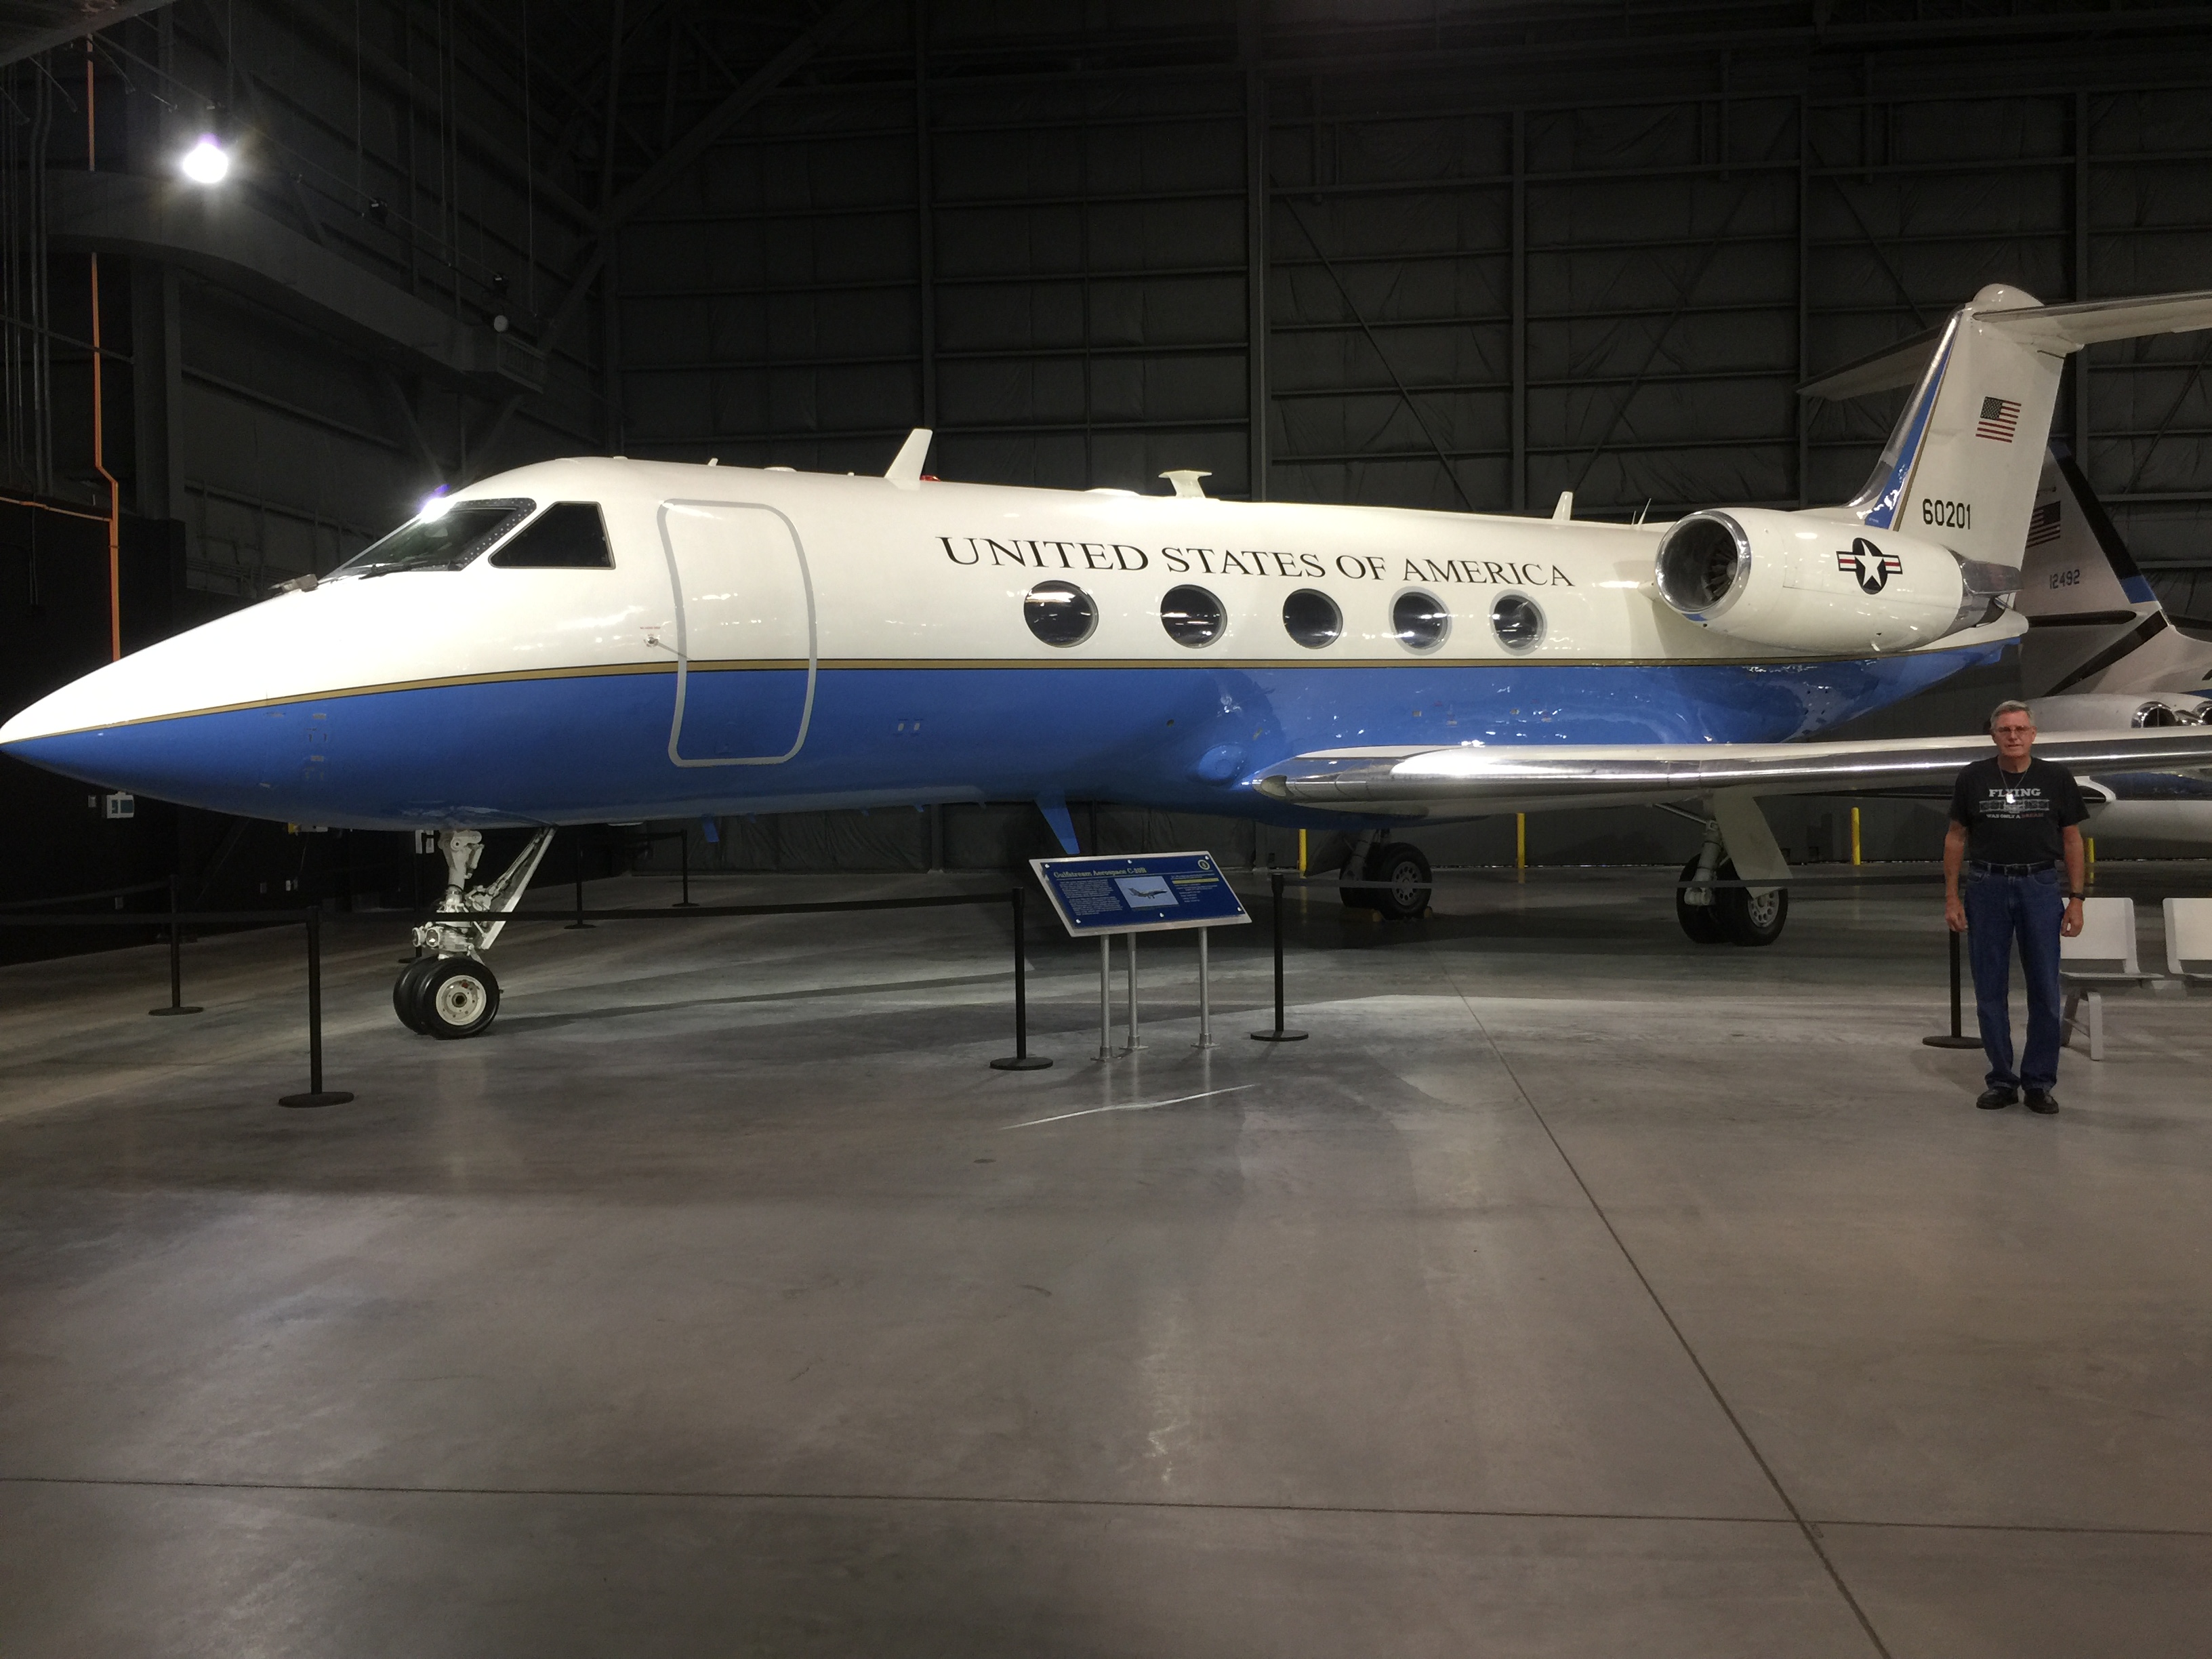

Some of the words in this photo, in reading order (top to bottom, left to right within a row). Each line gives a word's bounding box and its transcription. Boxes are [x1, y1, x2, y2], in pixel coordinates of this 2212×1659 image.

[1922, 498, 1971, 530] 60201
[935, 536, 1149, 571] UNITED
[1161, 546, 1326, 578] STATES
[1335, 554, 1387, 581] OF
[1402, 558, 1576, 587] AMERICA
[2049, 569, 2081, 590] 12492
